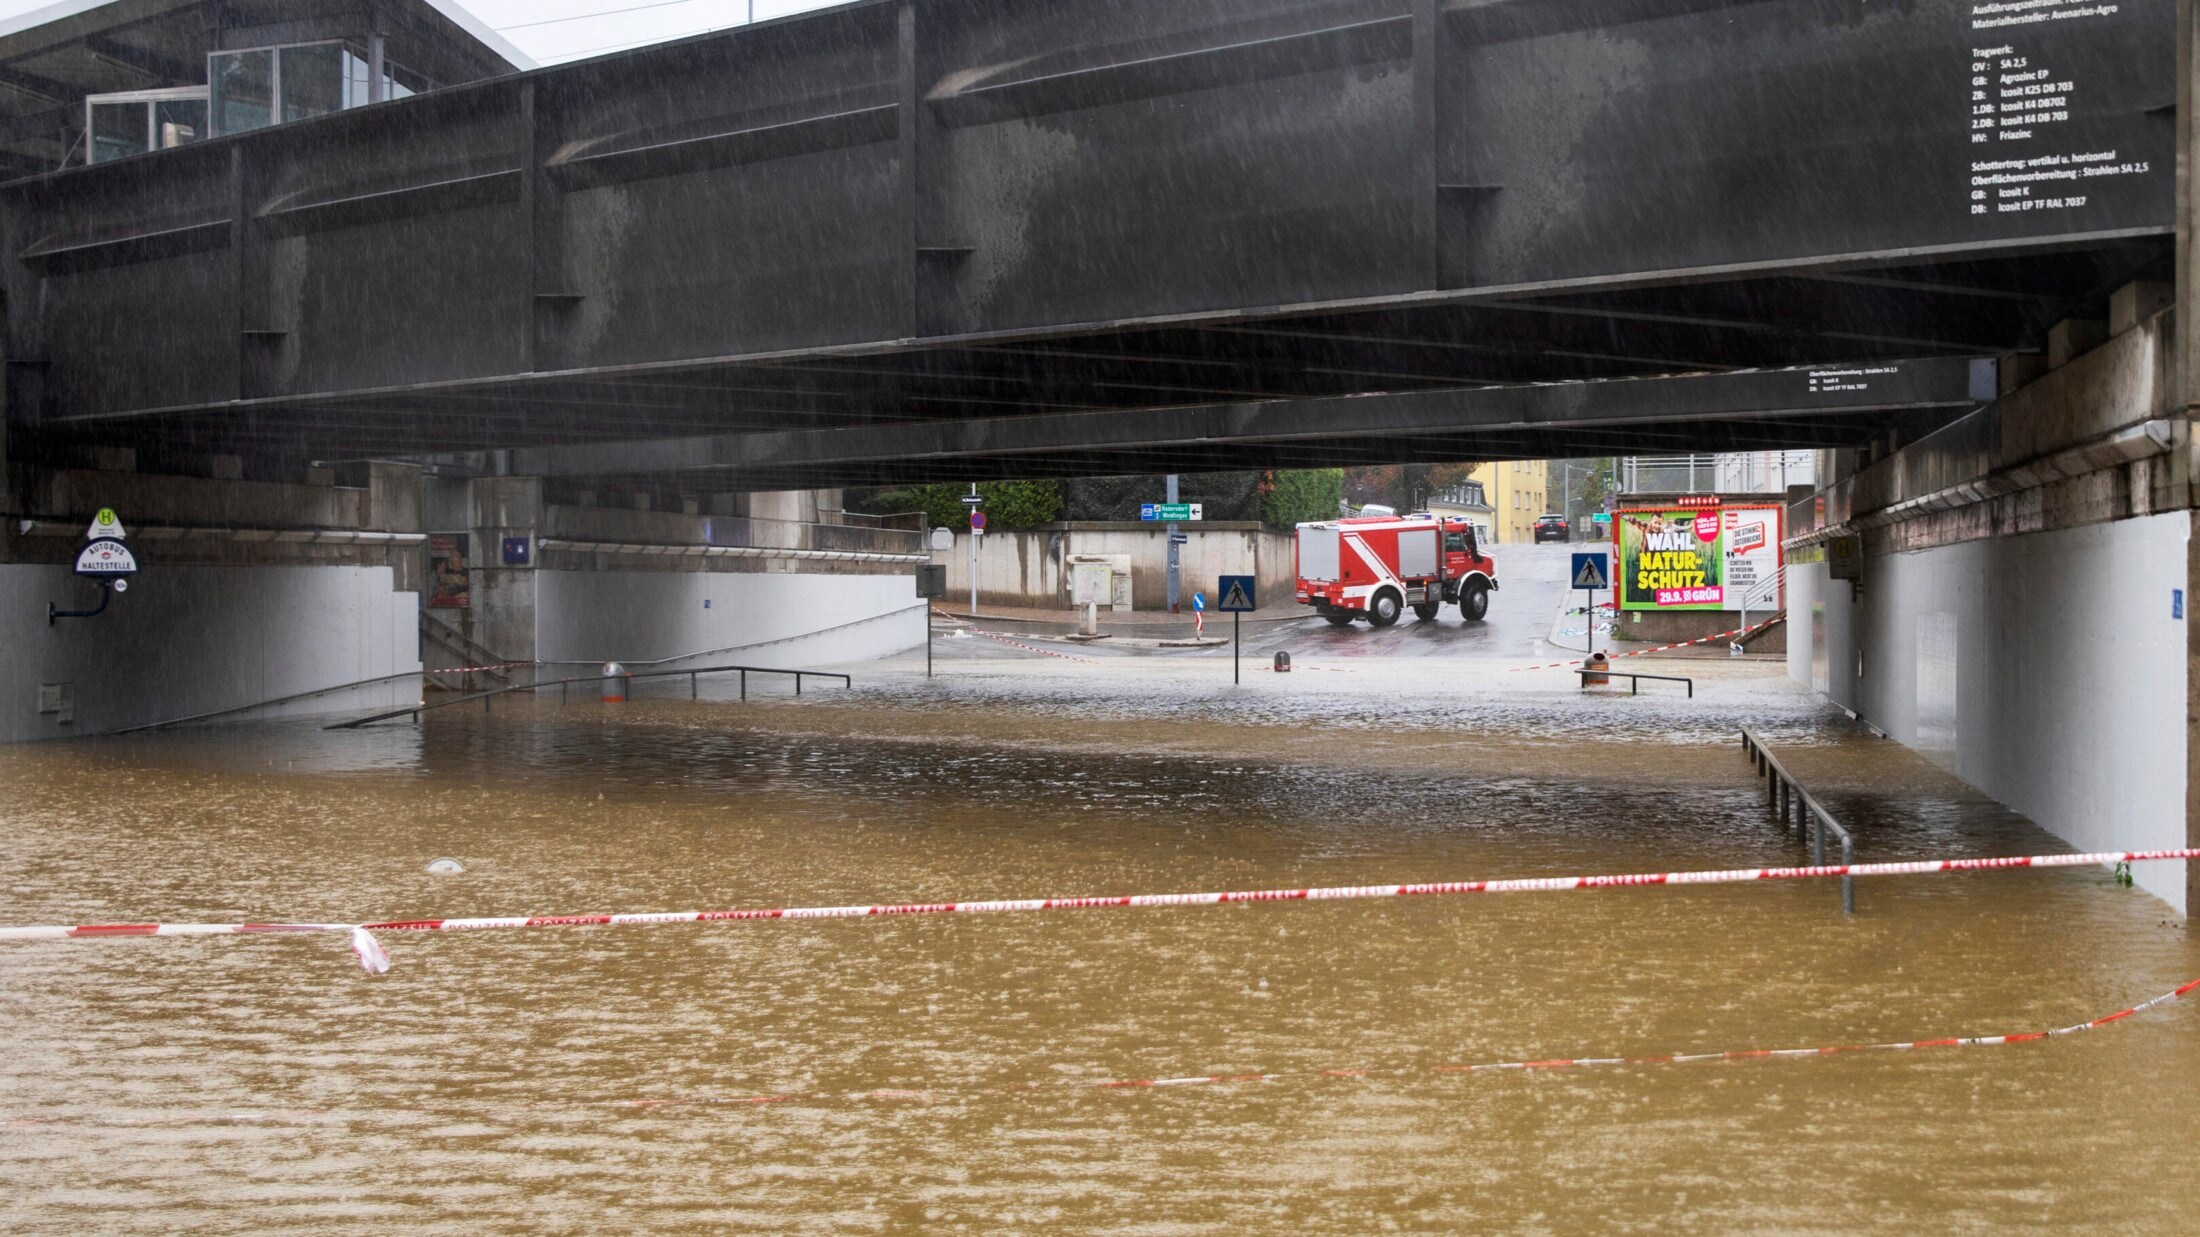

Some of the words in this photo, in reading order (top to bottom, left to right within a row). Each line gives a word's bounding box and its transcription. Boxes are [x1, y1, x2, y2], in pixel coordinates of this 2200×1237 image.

[1972, 13, 2050, 29] Materialhersteller:
[2051, 4, 2118, 20] Avenarius-Agro
[1972, 44, 2013, 58] Tragwerk:
[1972, 62, 1985, 72] OV
[2000, 59, 2012, 69] SA
[2013, 57, 2027, 68] 2,5
[1972, 76, 1987, 86] GB:
[2000, 71, 2036, 85] Agrozinc
[2037, 69, 2049, 80] EP
[1972, 90, 1986, 100] ZB:
[2000, 86, 2023, 97] Icosit
[2024, 84, 2041, 95] K25
[2042, 83, 2055, 93] DB
[2056, 81, 2074, 92] 703
[1972, 104, 1995, 114] 1.DB:
[2000, 101, 2023, 112] Icosit
[2024, 99, 2036, 109] K4
[1972, 118, 1995, 129] 2.DB:
[2000, 115, 2023, 126] Icosit
[2024, 113, 2036, 124] K4
[2037, 112, 2050, 122] DB
[2051, 111, 2068, 121] 703
[1972, 133, 1987, 143] HV:
[1999, 129, 2032, 140] Friazinc
[1971, 159, 2026, 172] Schottertrog:
[2027, 155, 2060, 167] vertikal
[2061, 156, 2070, 164] u.
[2071, 150, 2116, 163] horizontal
[1971, 168, 2077, 186] Oberflächenvorbereitung
[2083, 163, 2119, 177] Strahlen
[2120, 163, 2133, 174] SA
[2134, 162, 2149, 173] 2,5
[1971, 190, 1987, 200] GB:
[1999, 187, 2022, 198] Icosit
[2022, 187, 2029, 196] K
[1971, 204, 1987, 214] DB:
[1998, 202, 2021, 212] Icosit
[2022, 200, 2033, 210] EP
[2034, 199, 2045, 209] TF
[2046, 198, 2063, 208] RAL
[2064, 196, 2087, 207] 7037
[101, 511, 111, 522] H
[1645, 528, 1696, 551] WÄHL
[88, 543, 124, 556] AUTOBUS
[1639, 552, 1703, 570] NATUR-
[1637, 570, 1705, 590] SCHUTZ
[1660, 591, 1682, 602] 29.9.
[1692, 588, 1720, 601] GRÜN
[1228, 890, 1289, 901] POLIZEI
[1406, 882, 1468, 894] POLIZEI
